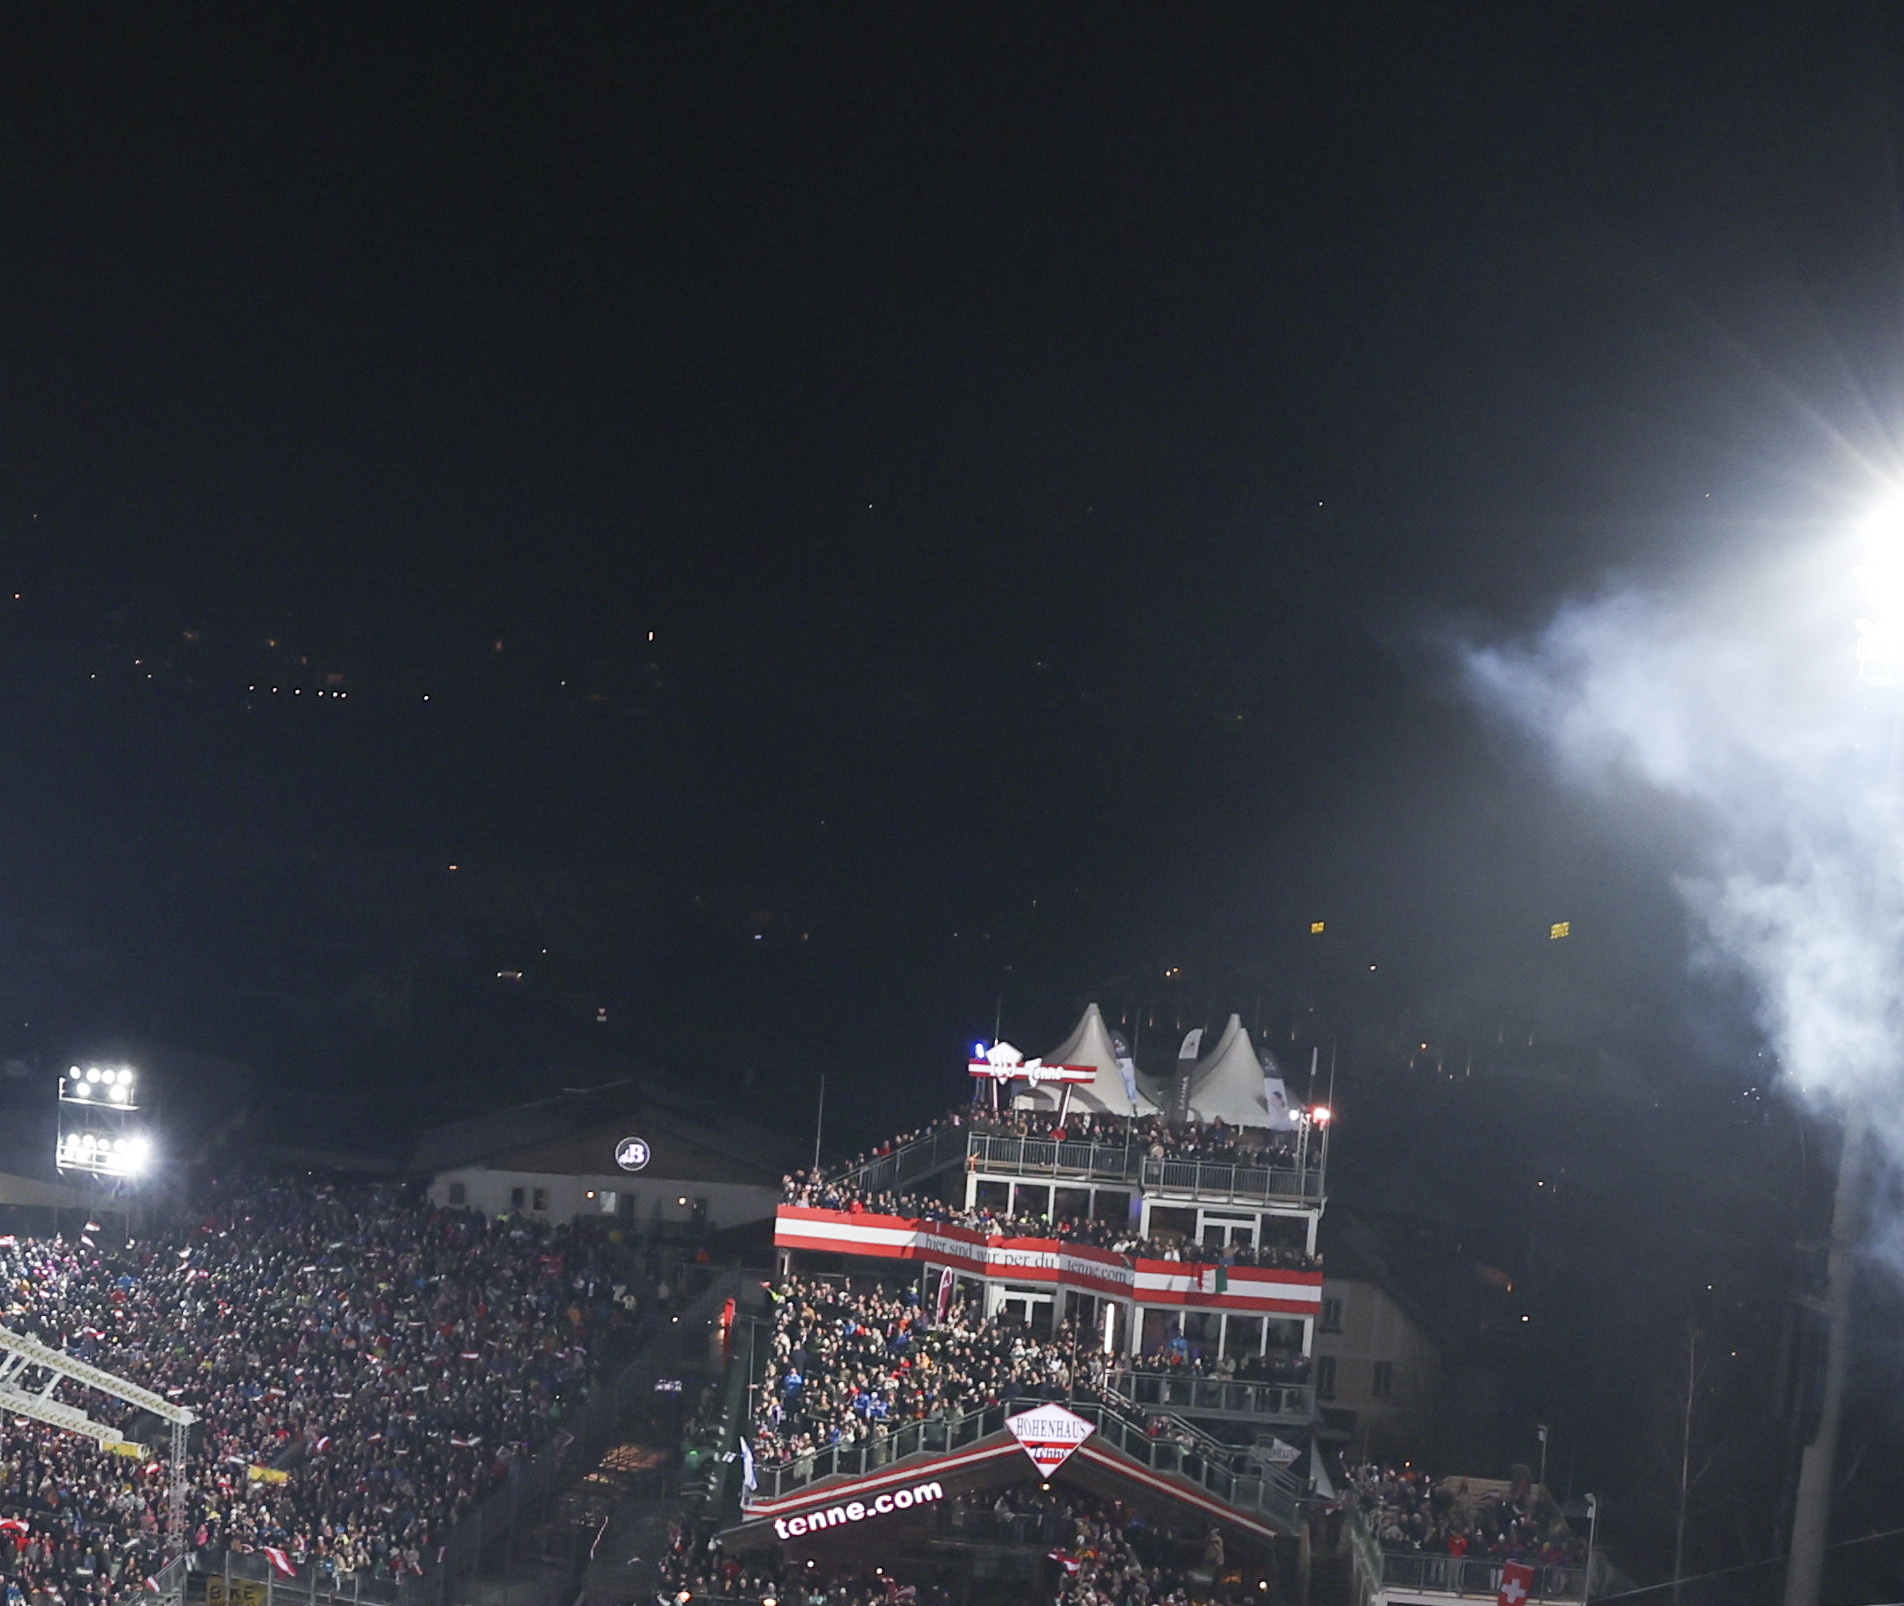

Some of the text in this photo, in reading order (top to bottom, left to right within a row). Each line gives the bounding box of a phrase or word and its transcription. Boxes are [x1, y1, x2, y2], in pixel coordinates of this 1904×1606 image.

[1034, 1252, 1054, 1269] du
[1016, 1416, 1086, 1439] HOHENHAUS
[773, 1481, 944, 1540] tenne.com
[210, 1585, 254, 1600] BKE
